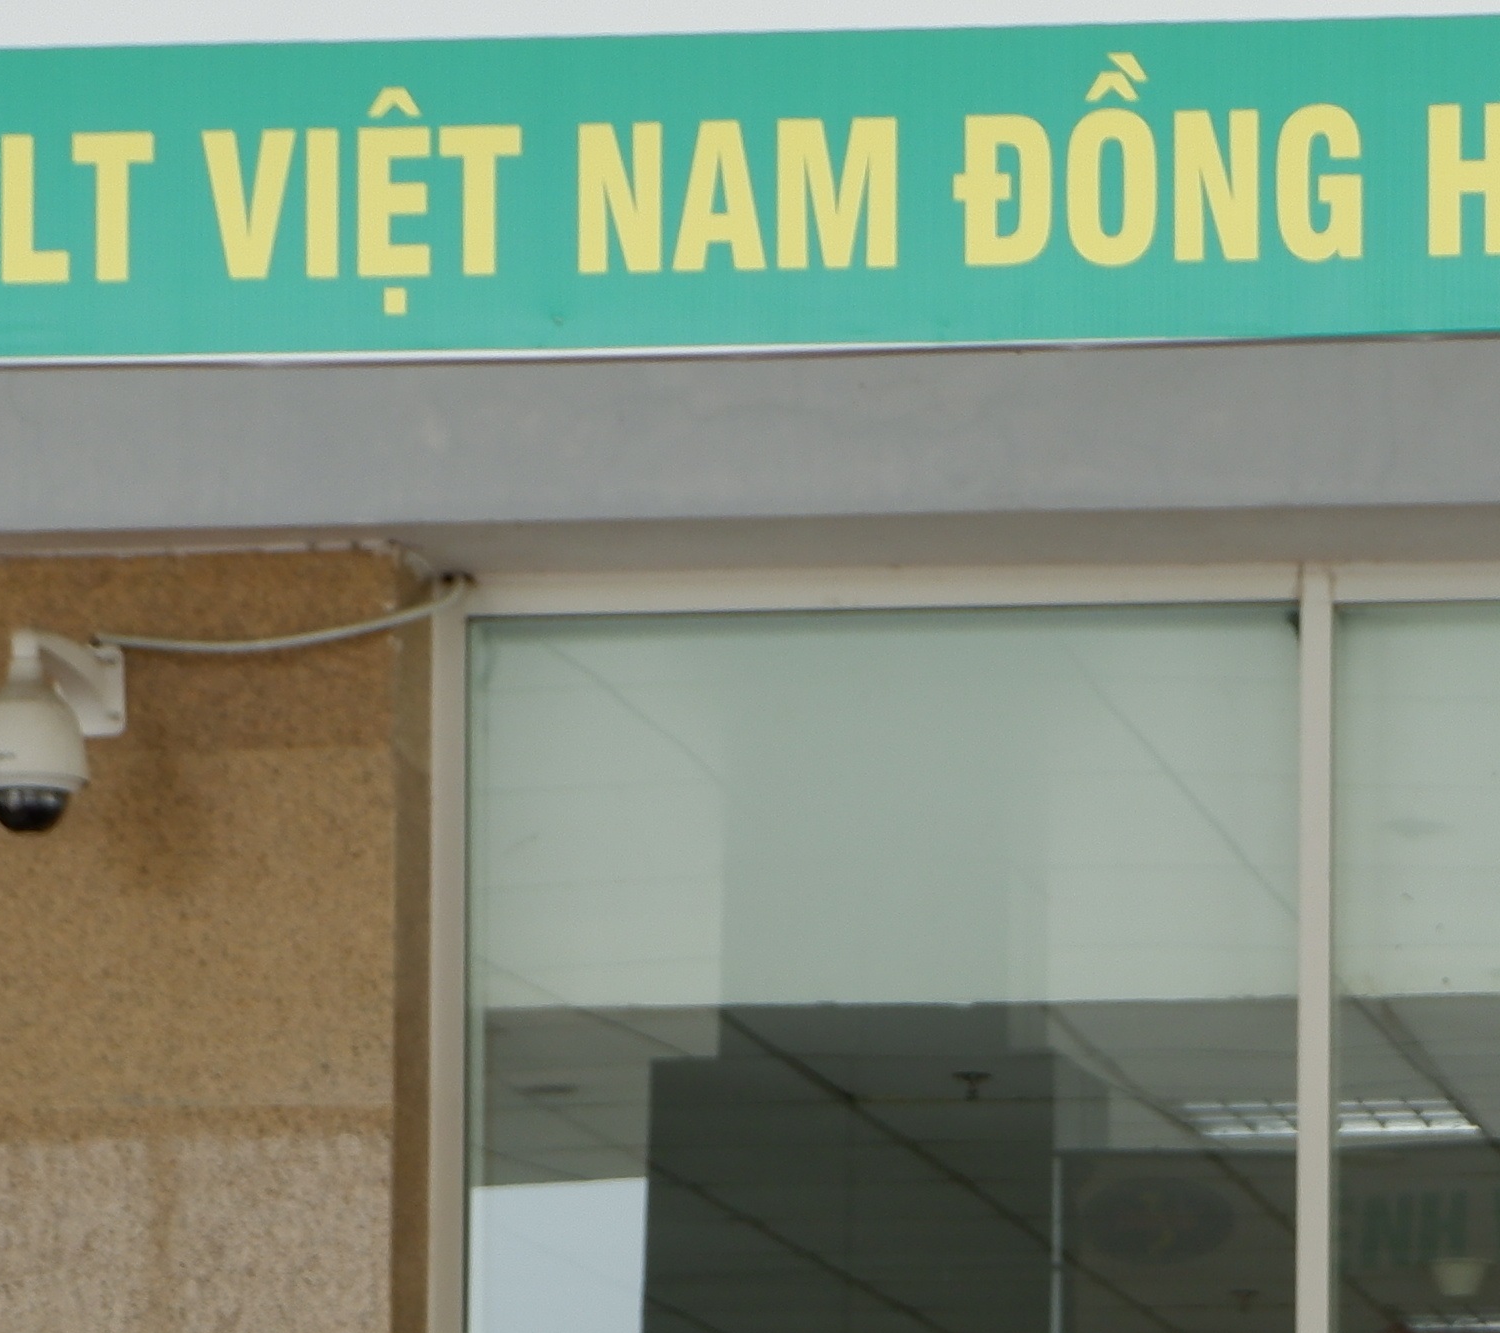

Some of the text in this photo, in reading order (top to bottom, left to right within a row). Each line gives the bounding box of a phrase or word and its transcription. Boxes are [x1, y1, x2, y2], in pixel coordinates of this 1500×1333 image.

[205, 89, 519, 312] VIỆT
[581, 119, 895, 271] NAM
[956, 54, 1360, 264] ĐỒNG
